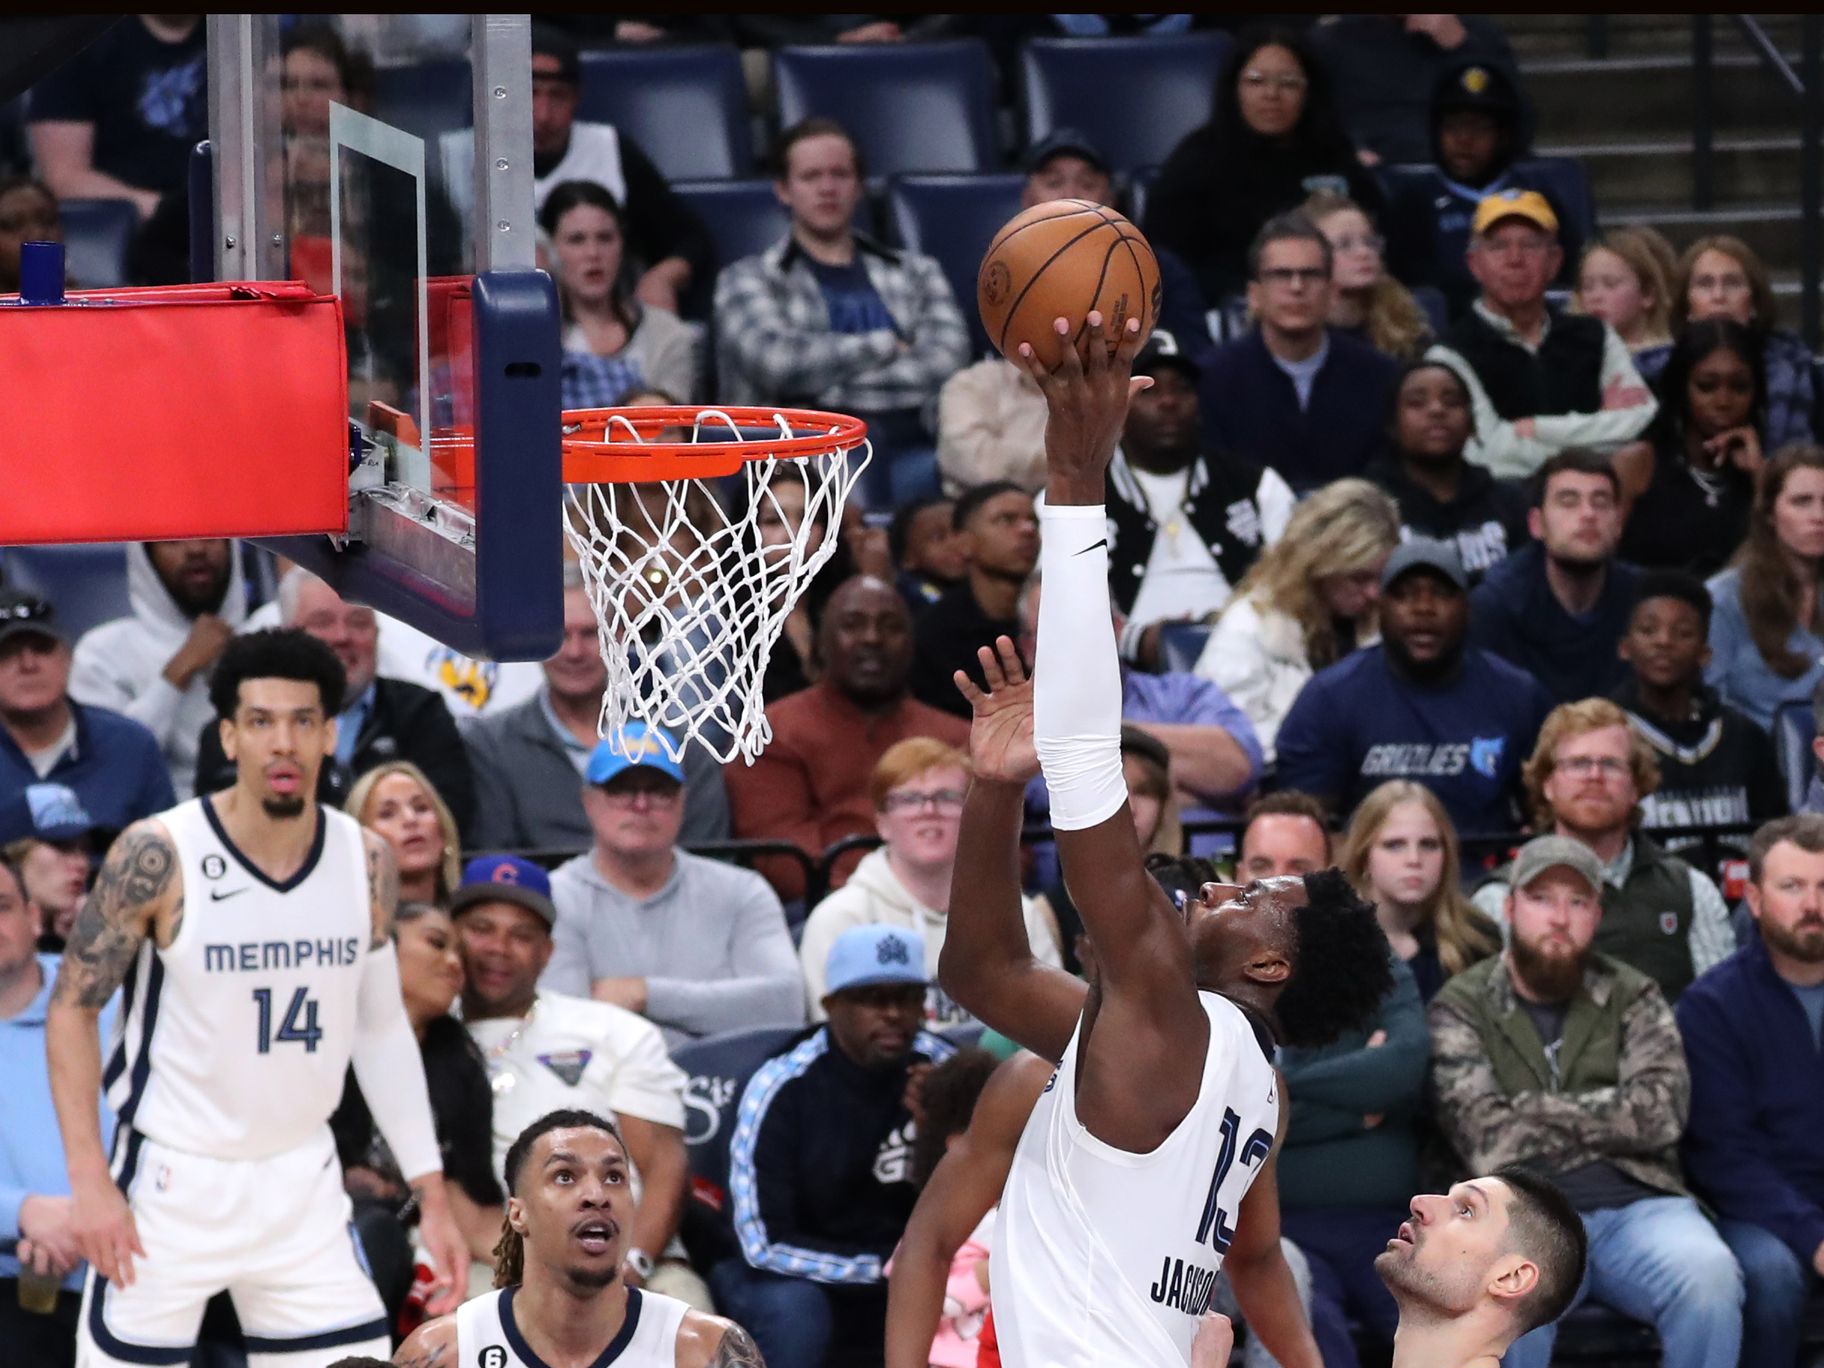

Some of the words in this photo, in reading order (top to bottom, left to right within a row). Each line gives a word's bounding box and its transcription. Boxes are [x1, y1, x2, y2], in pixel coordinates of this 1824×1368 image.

[204, 938, 358, 971] MEMPHIS
[252, 986, 323, 1054] 14
[1150, 1255, 1220, 1316] JACKSO
